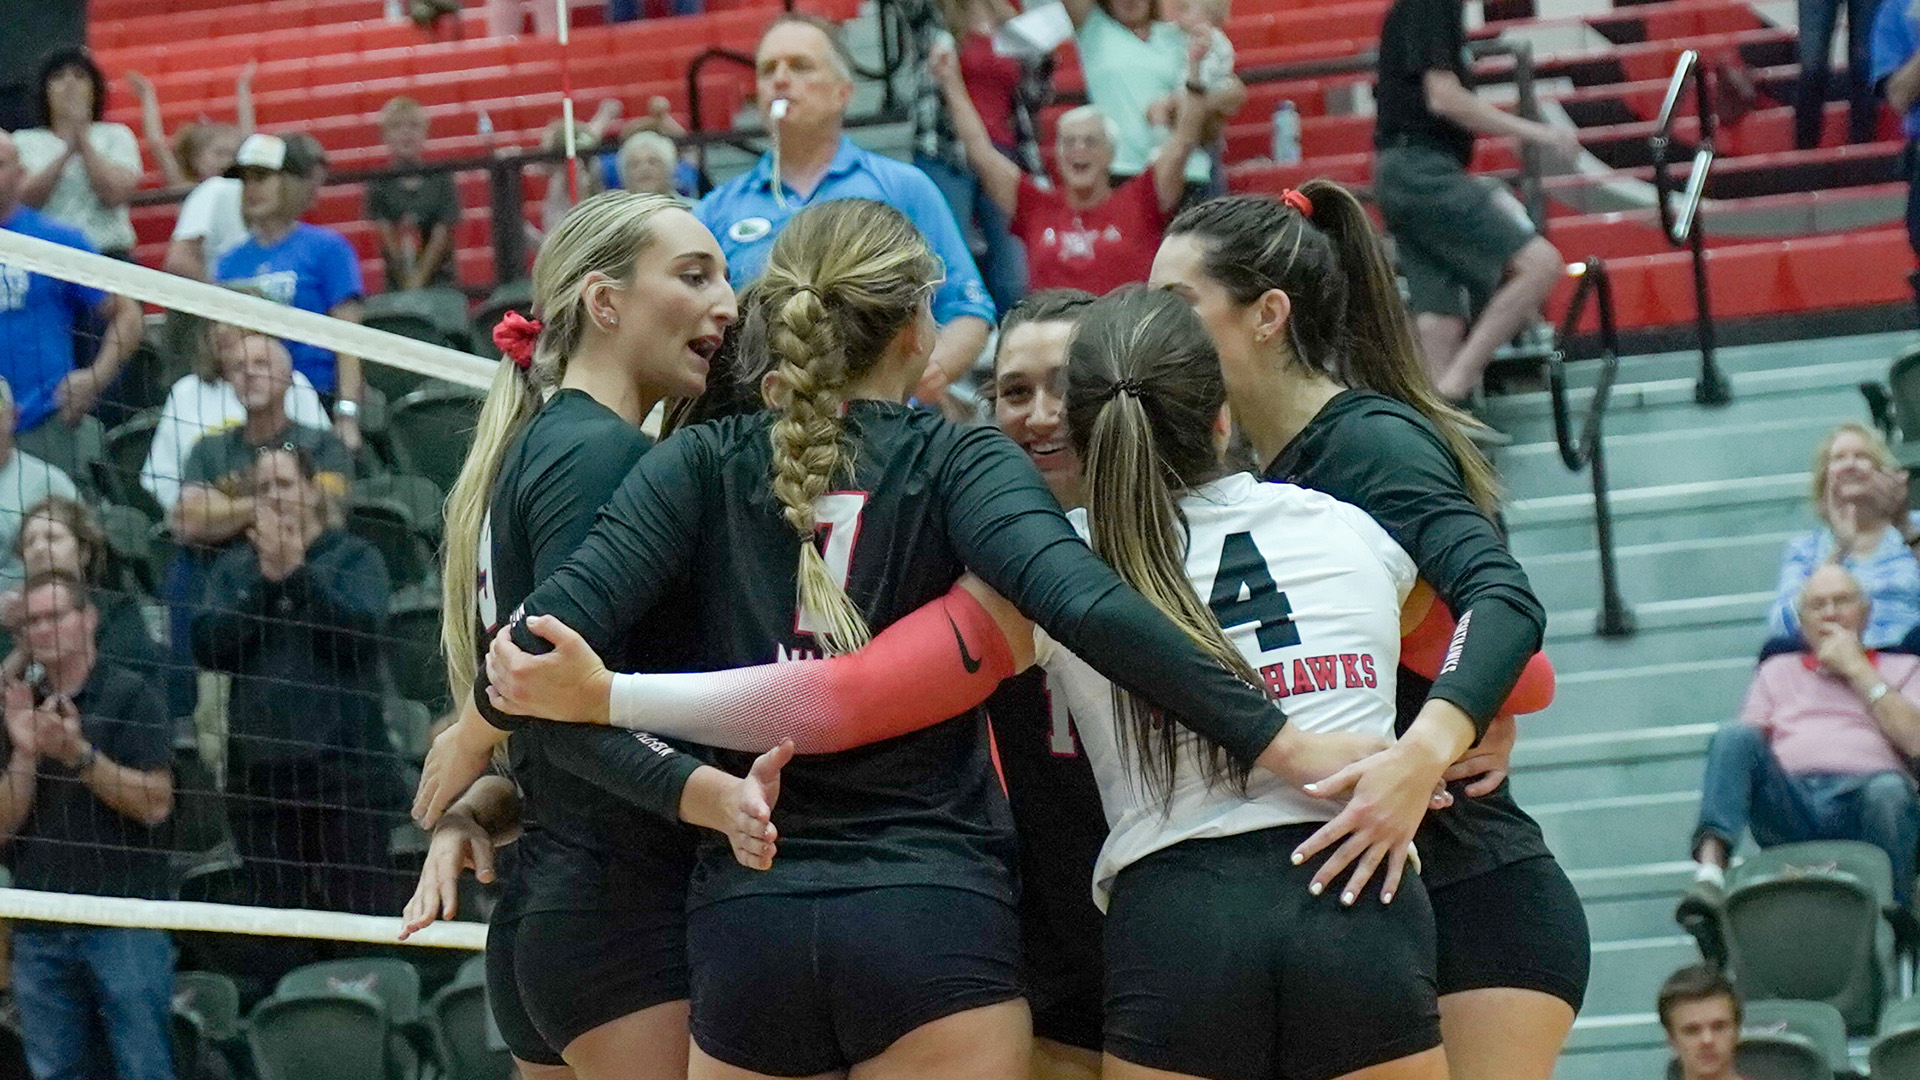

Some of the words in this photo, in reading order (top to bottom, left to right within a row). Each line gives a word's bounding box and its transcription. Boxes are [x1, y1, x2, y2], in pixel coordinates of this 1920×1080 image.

[794, 490, 869, 635] 7
[1207, 530, 1302, 653] 4
[1254, 653, 1378, 700] HAWKS
